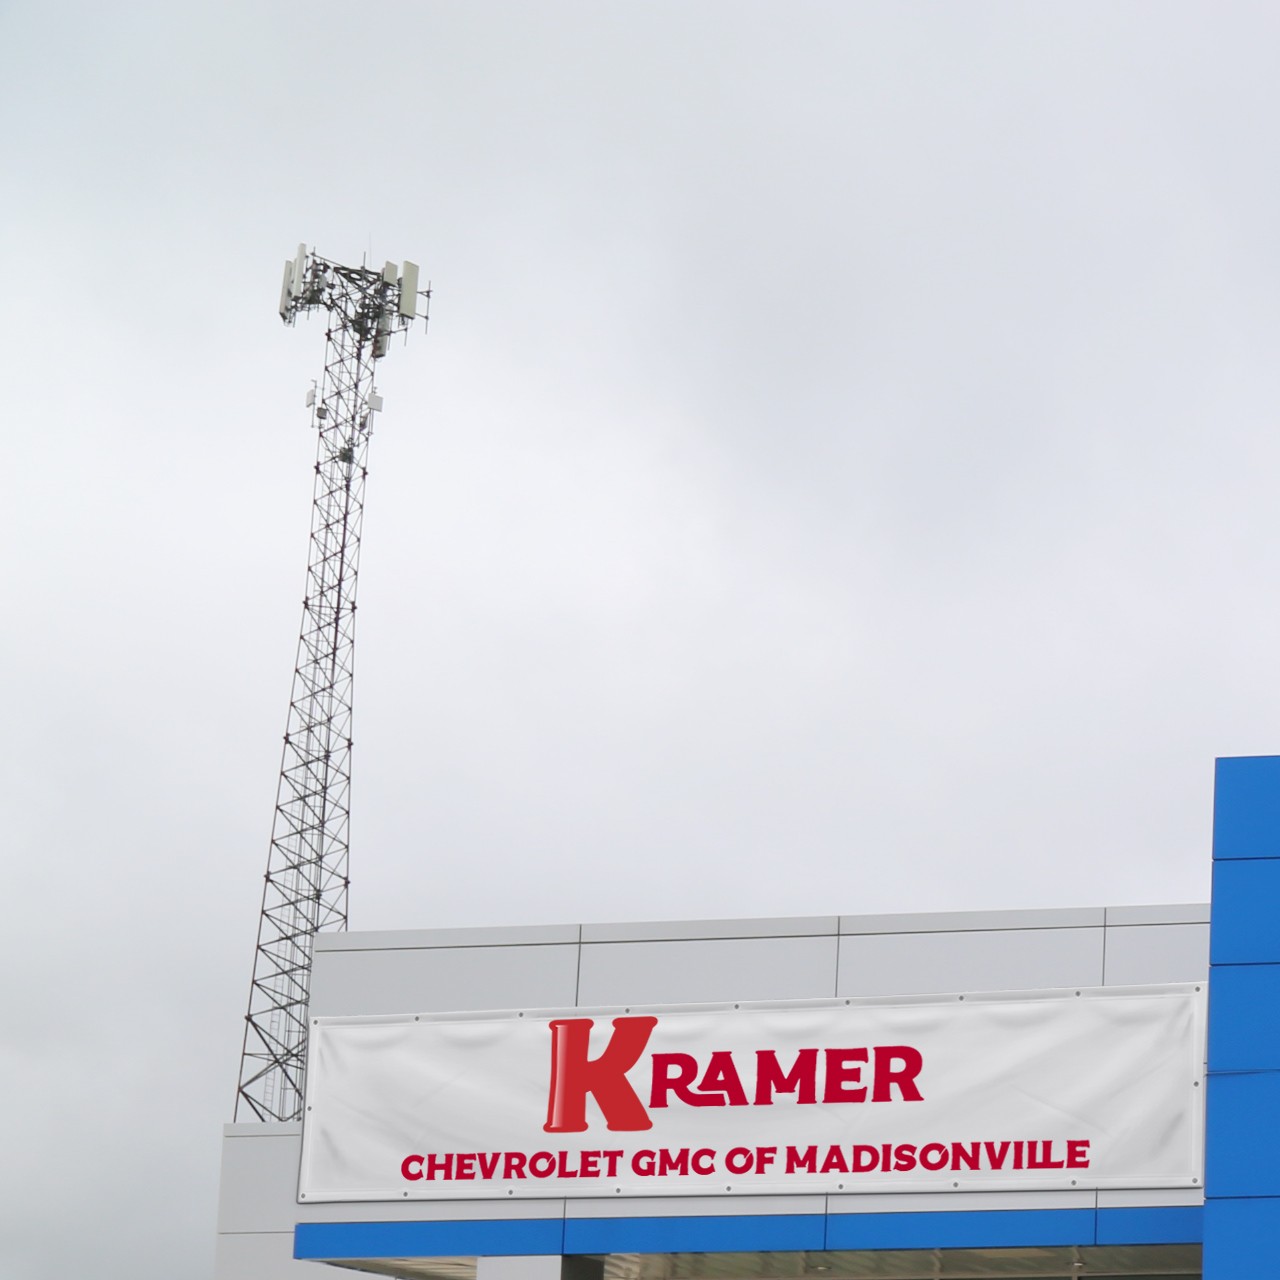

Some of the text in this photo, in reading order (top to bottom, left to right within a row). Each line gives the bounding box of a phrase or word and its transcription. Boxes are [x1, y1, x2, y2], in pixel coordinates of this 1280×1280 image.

[542, 1015, 925, 1134] KRAMER
[400, 1139, 1091, 1182] CHEVROLET GMC OF MADISONVILLE
